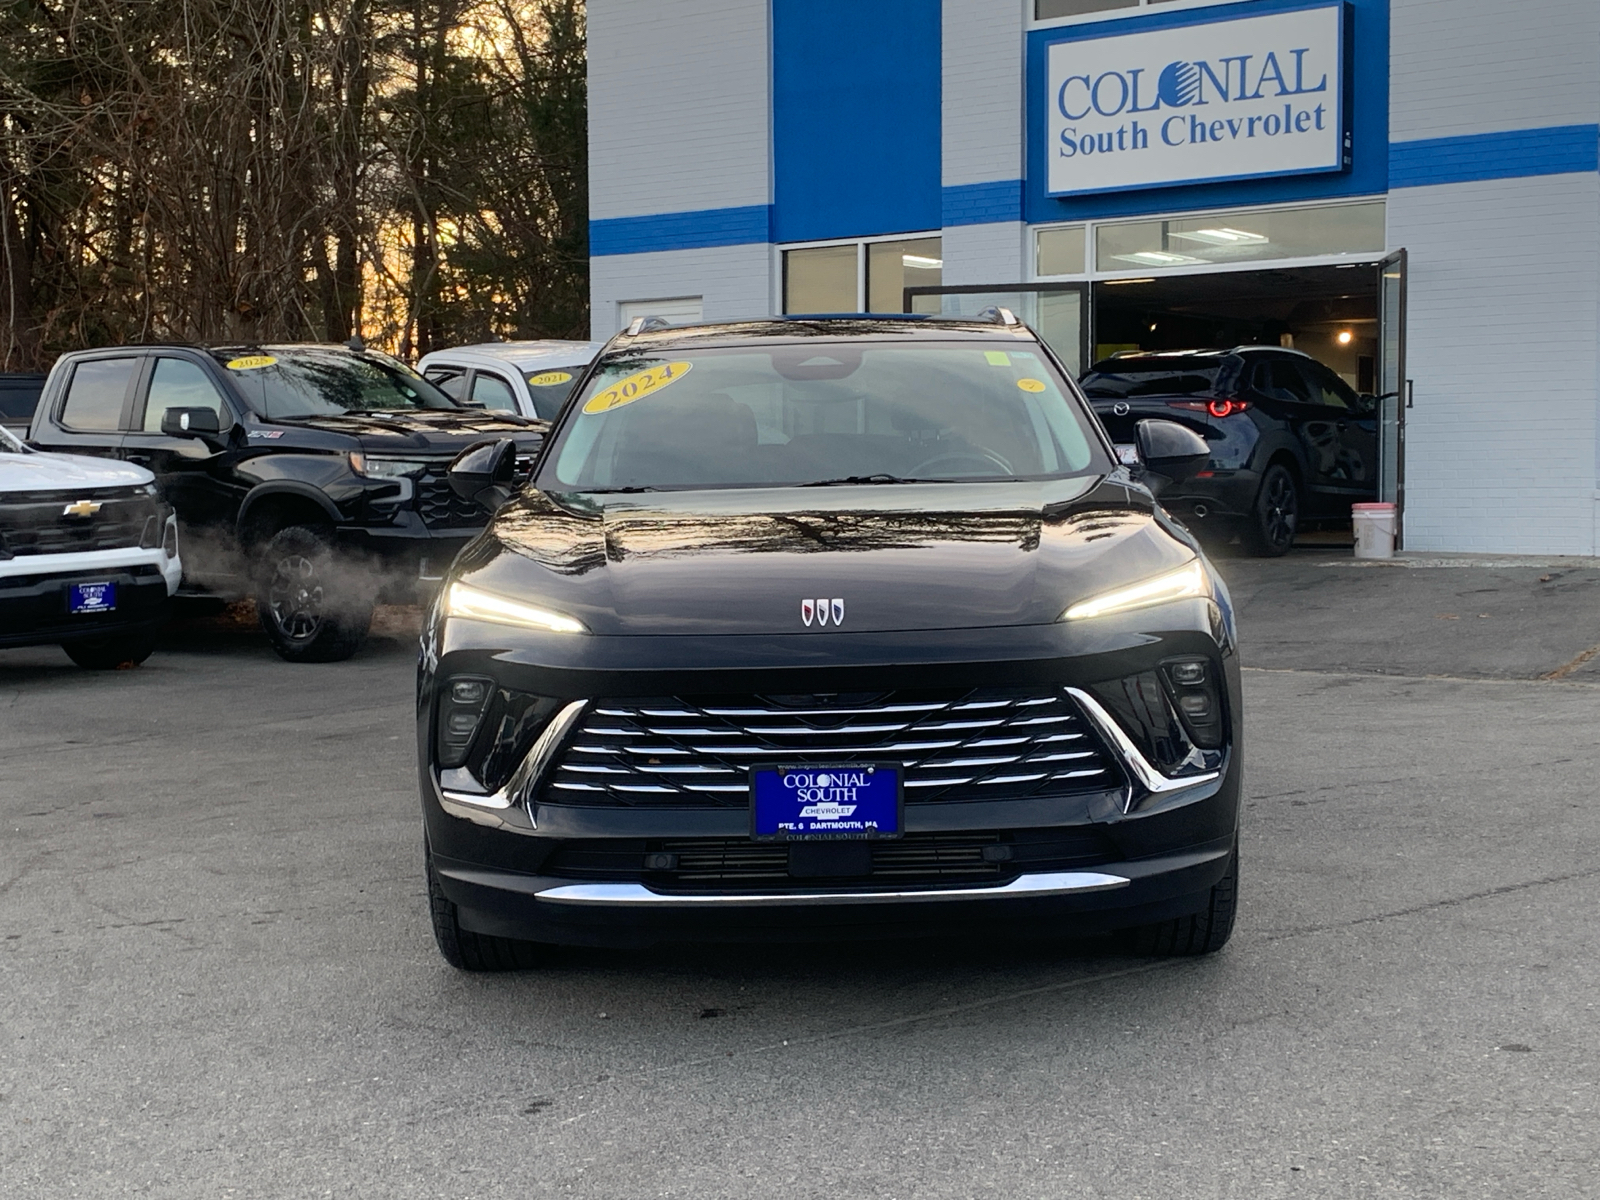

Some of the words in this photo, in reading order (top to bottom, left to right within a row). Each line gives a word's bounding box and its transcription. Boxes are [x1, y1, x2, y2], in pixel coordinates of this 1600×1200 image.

[1058, 47, 1327, 120] COLONIAL
[1059, 120, 1148, 158] South
[1161, 102, 1326, 146] Chevrolet
[538, 373, 563, 384] 2021
[604, 364, 674, 407] 2024
[783, 773, 871, 789] COLONIAL
[797, 788, 857, 803] SOUTH
[805, 807, 850, 815] CHEVROLET
[798, 822, 804, 830] 6
[810, 821, 863, 830] DARTMOUTH,
[865, 821, 878, 829] MA
